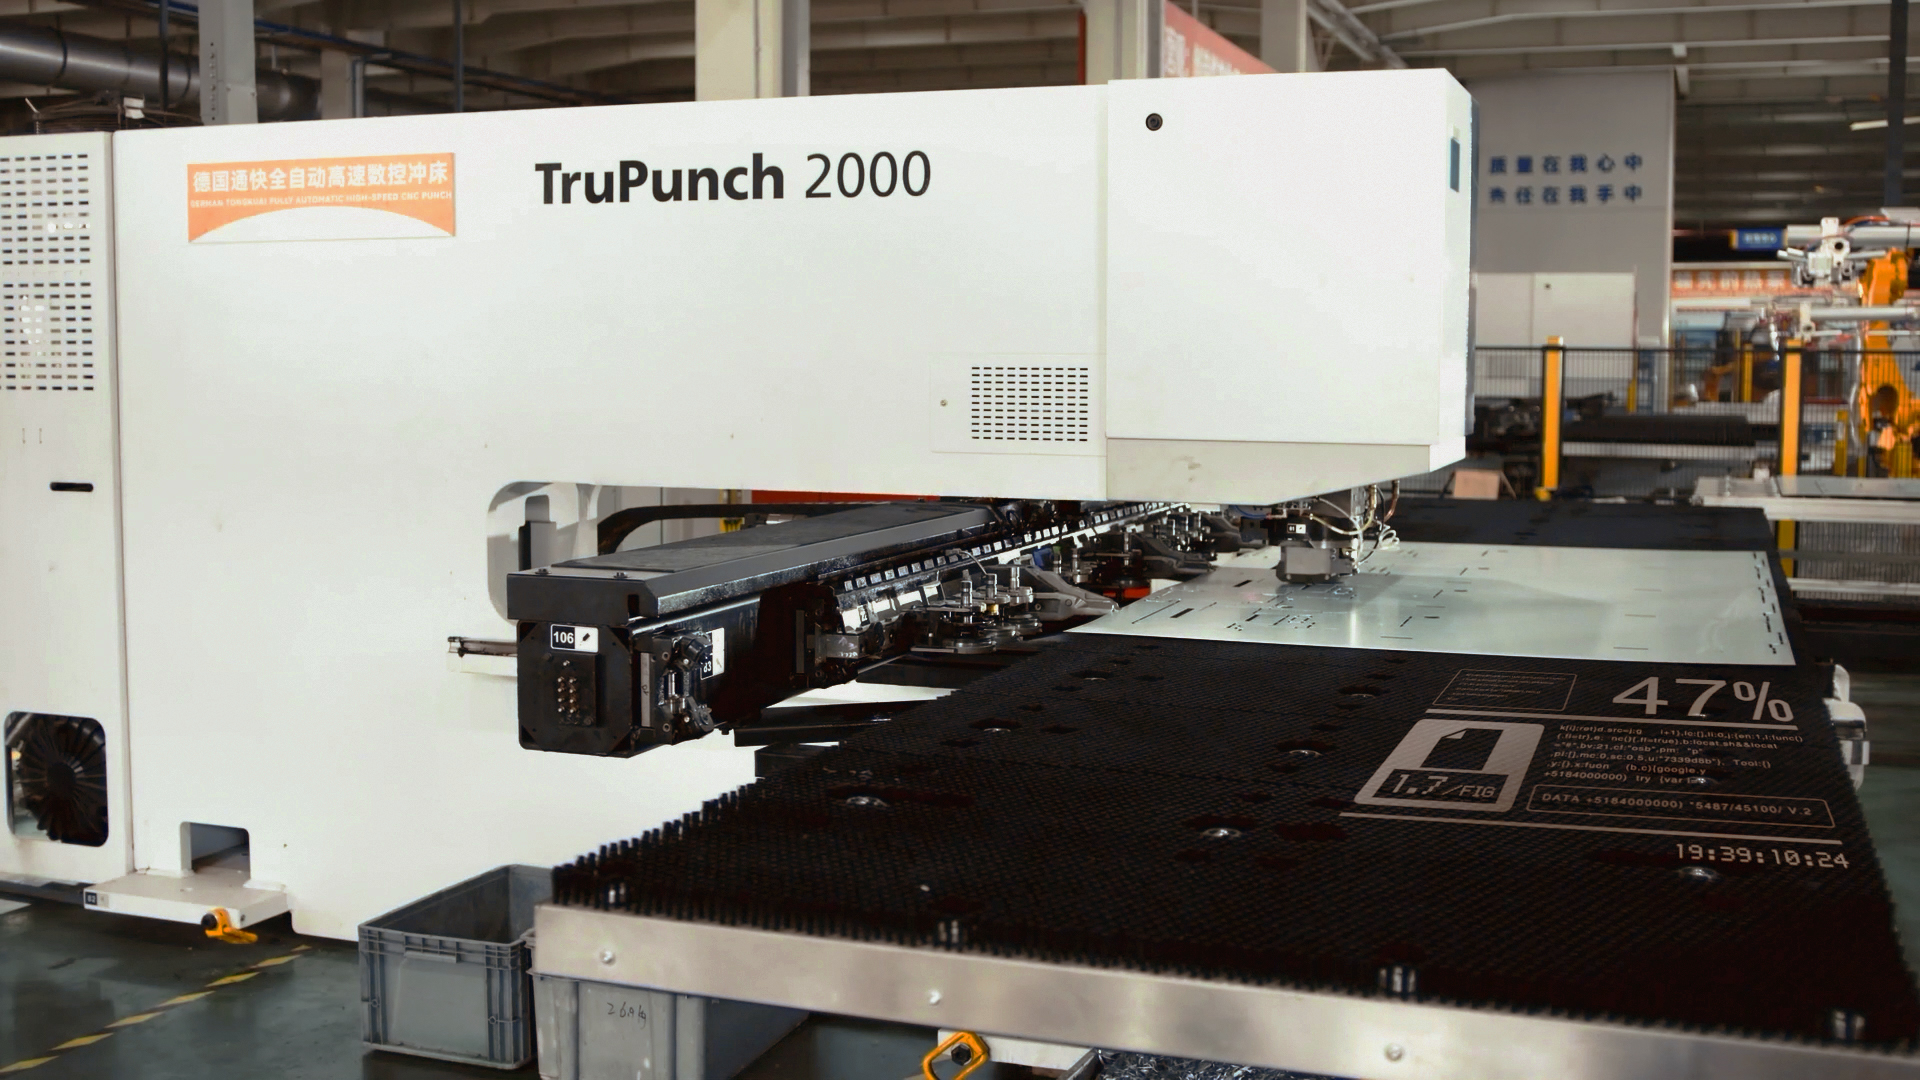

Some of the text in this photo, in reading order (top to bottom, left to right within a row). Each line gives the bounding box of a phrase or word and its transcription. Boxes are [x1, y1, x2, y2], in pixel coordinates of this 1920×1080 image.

[193, 160, 449, 193] 德国通快全自动高速数控冲床
[535, 150, 931, 205] TruPunch 2000
[190, 190, 452, 209] GERMAN TONGKUAI FULLY AUTOMATIC HIGH-SPEED CNC PUNCH
[553, 631, 575, 645] 106
